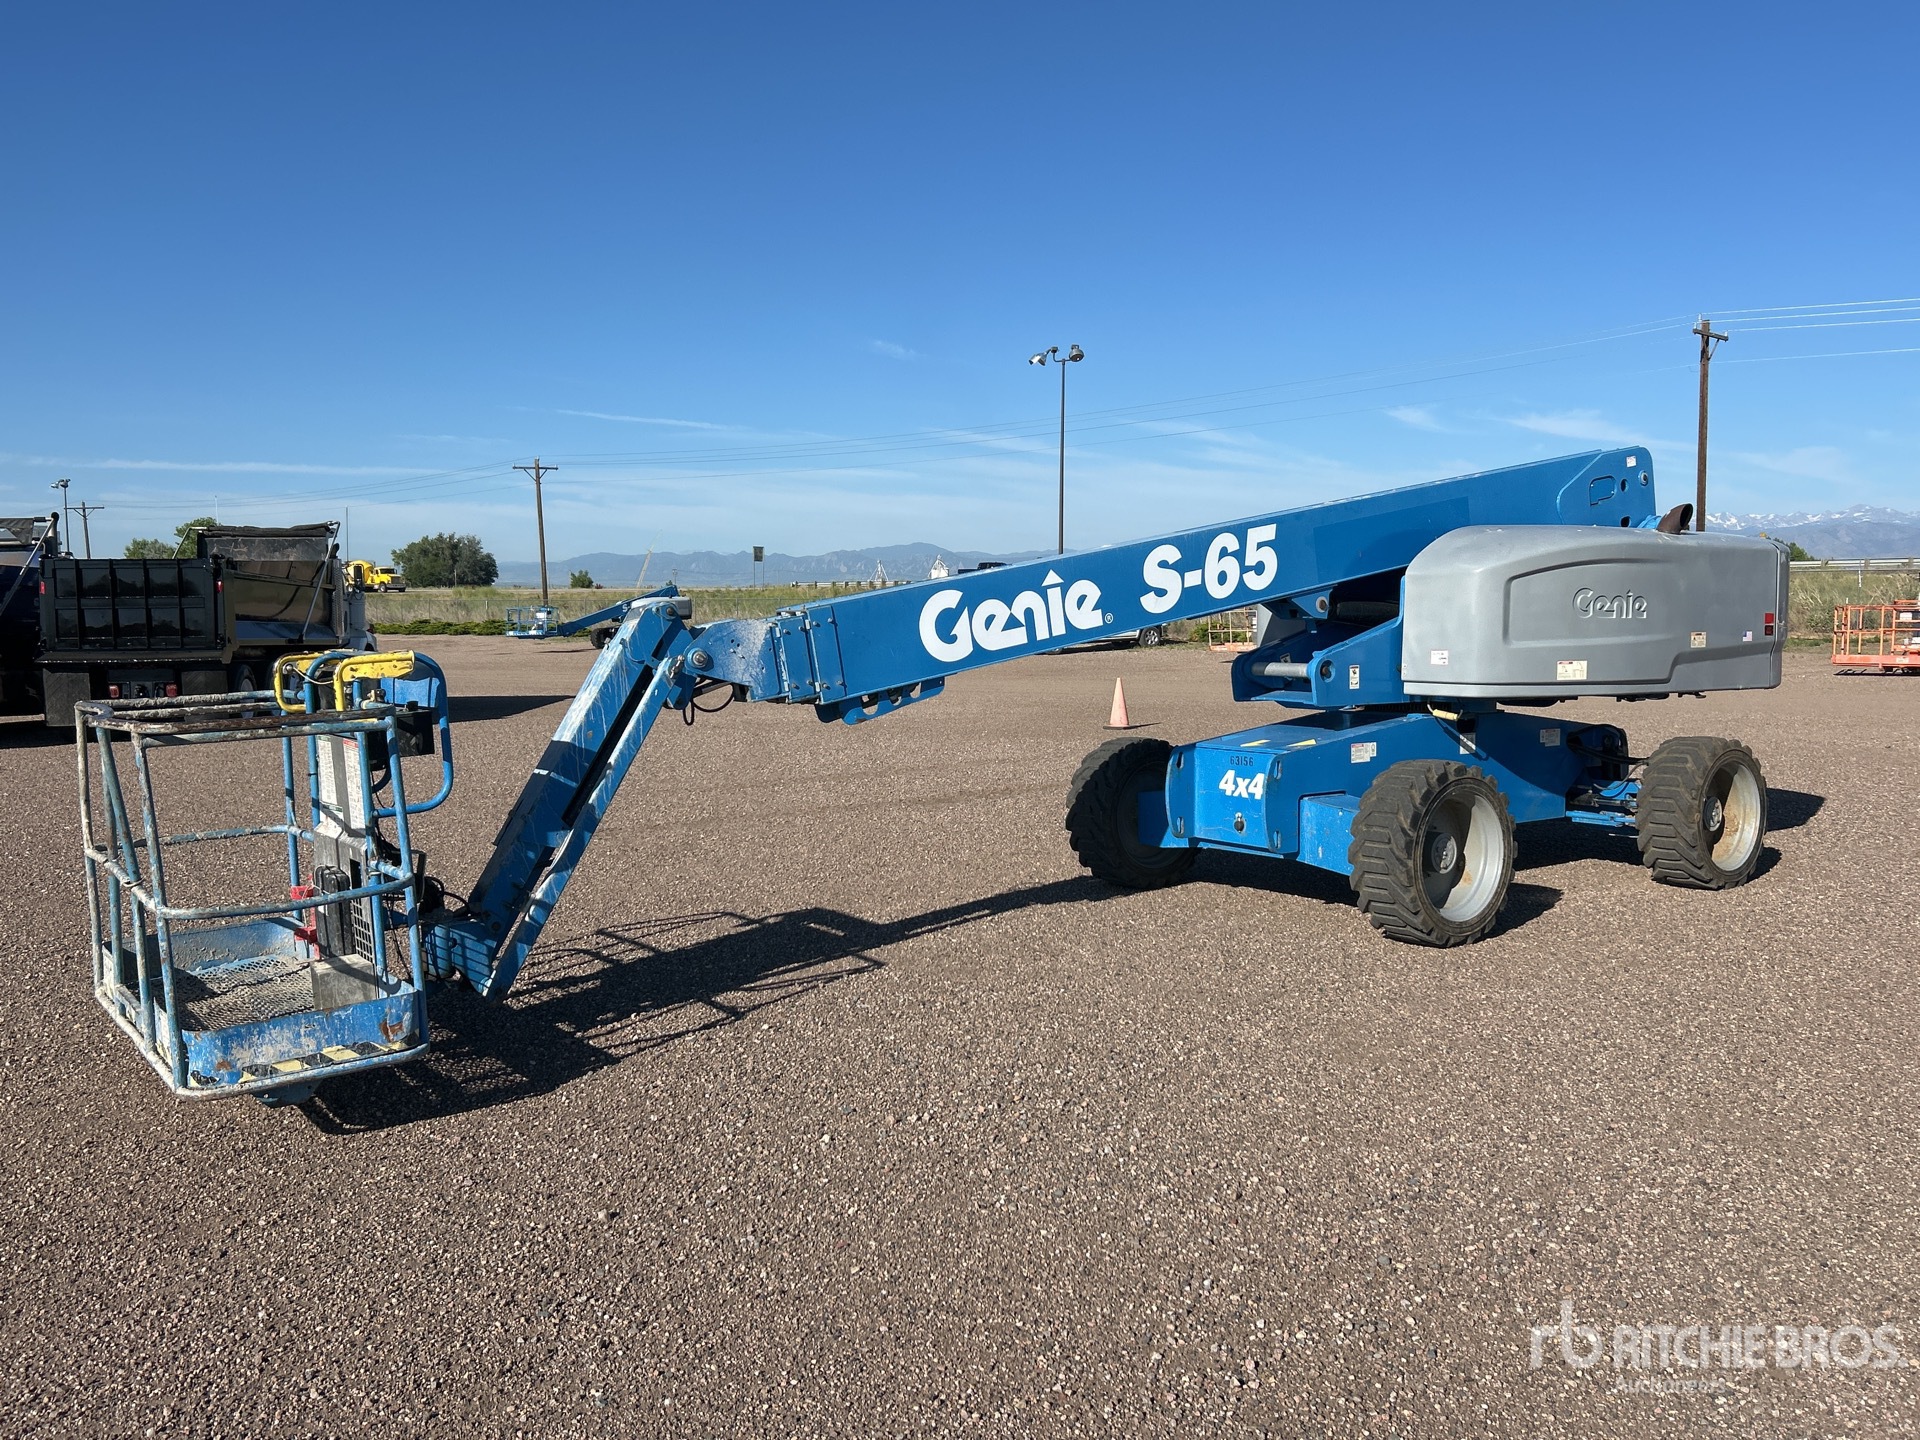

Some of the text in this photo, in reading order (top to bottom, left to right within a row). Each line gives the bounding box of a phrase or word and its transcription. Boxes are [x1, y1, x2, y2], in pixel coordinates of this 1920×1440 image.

[1140, 523, 1278, 614] S-65
[1573, 587, 1647, 619] Genie
[1230, 755, 1254, 767] 63156
[1218, 769, 1265, 800] 4x4
